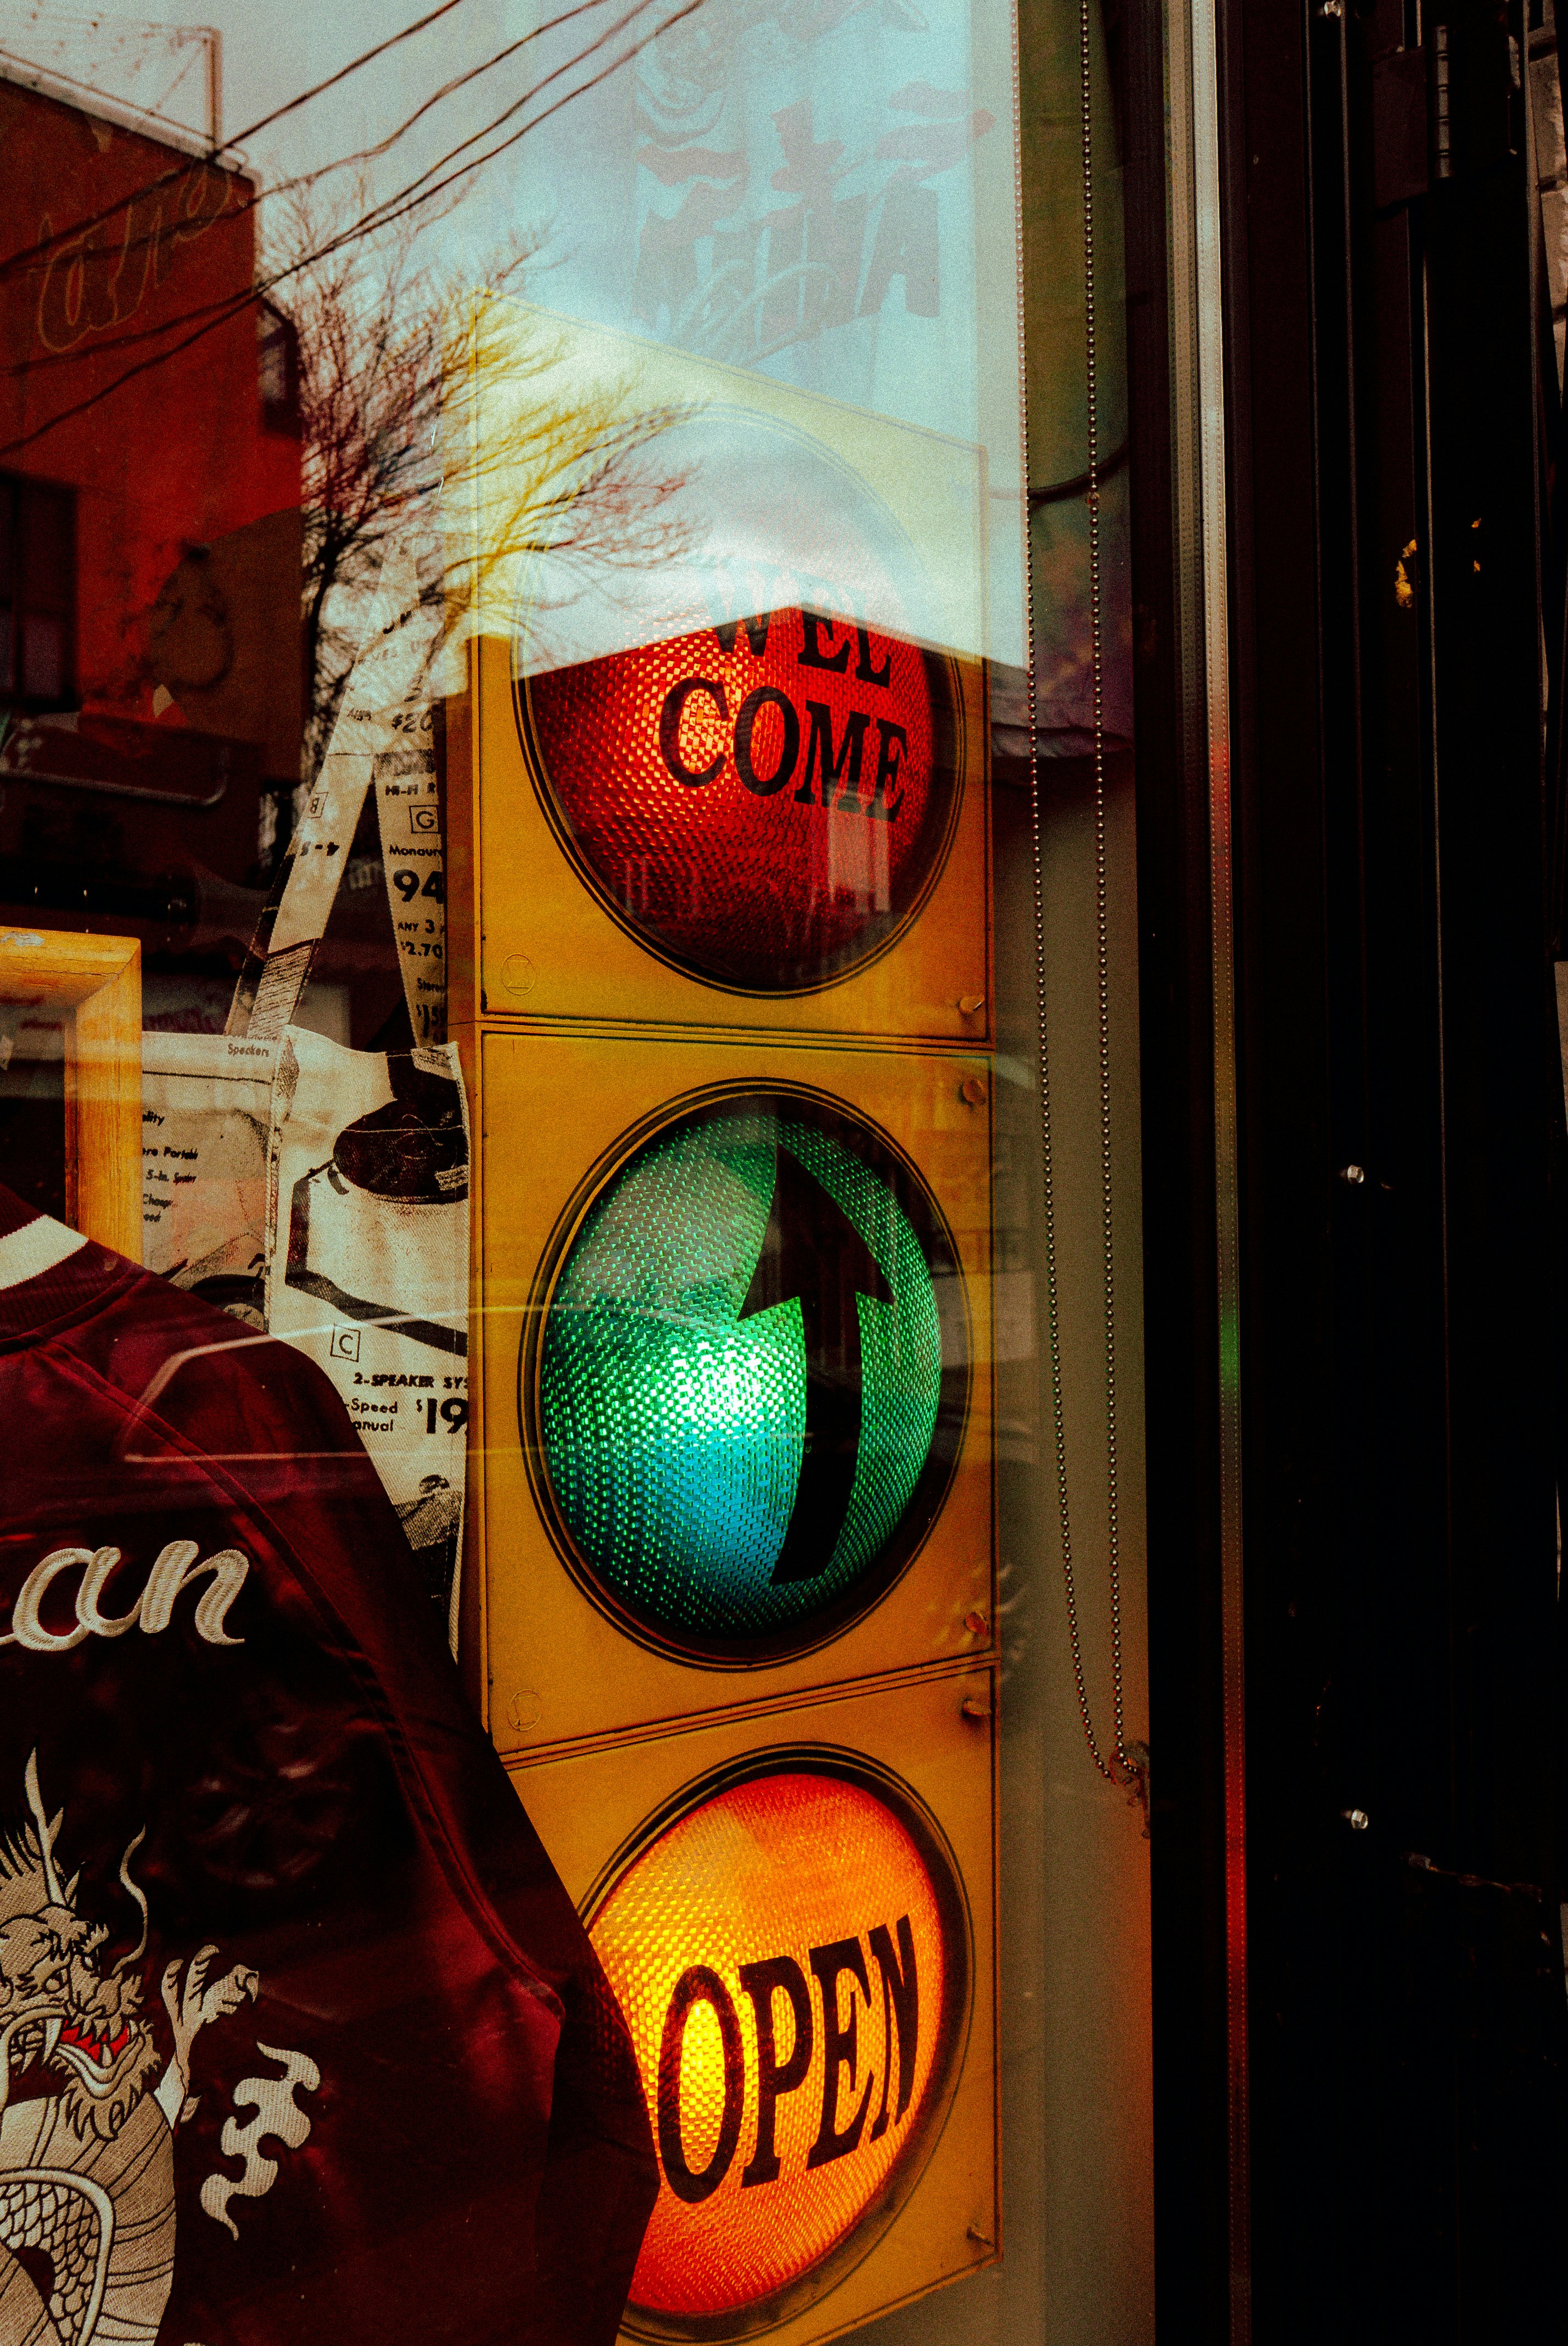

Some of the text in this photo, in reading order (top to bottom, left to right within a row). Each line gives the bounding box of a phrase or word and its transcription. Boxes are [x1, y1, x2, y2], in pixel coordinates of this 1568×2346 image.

[702, 556, 892, 688] WEL
[659, 677, 908, 823] COME
[416, 811, 435, 829] G
[394, 869, 444, 904] 94
[425, 919, 435, 934] 3
[228, 1043, 270, 1057] Speakers
[339, 1333, 354, 1355] C
[353, 1372, 434, 1388] 2-SPEAKER
[0, 1540, 249, 1651] an
[657, 1913, 920, 2204] OPEN
